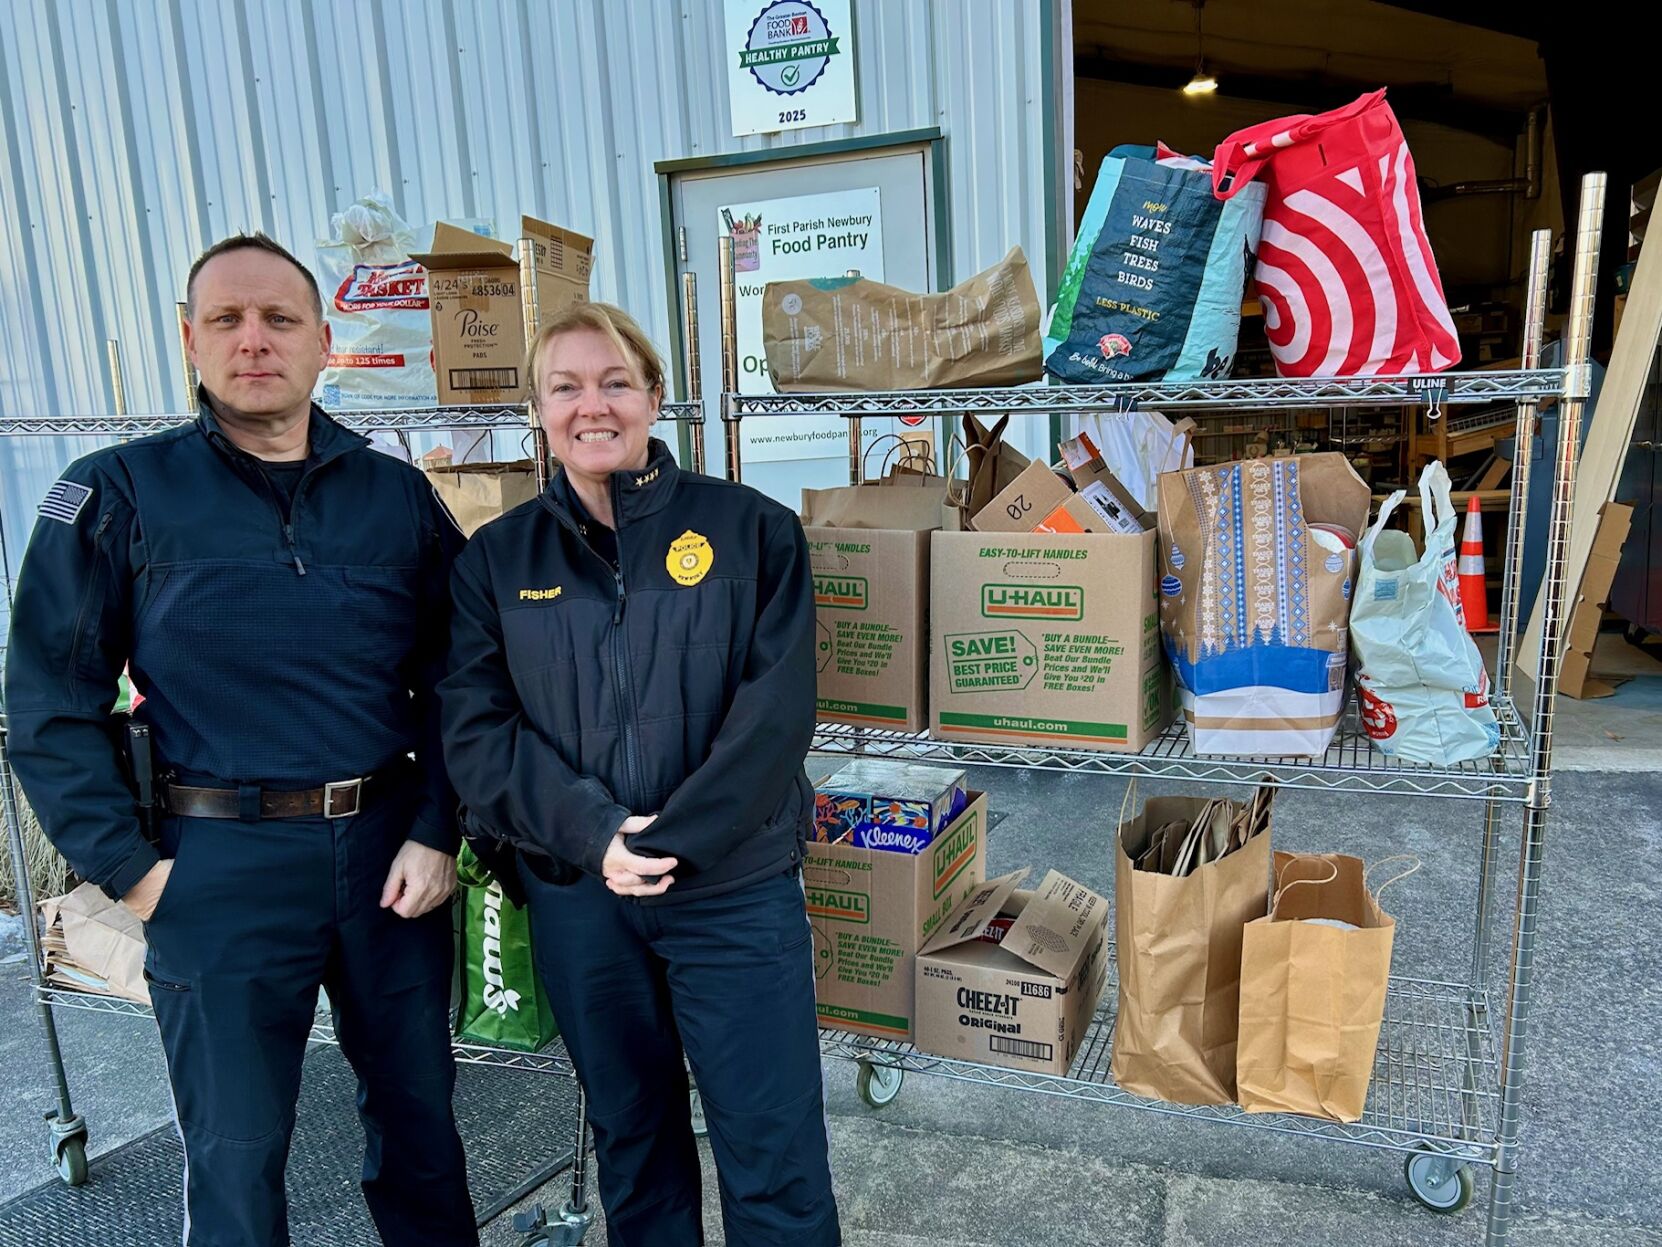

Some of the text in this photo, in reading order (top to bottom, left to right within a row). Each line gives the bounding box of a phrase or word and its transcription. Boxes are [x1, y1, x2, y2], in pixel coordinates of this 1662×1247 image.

[767, 19, 791, 31] FOOD
[768, 28, 792, 40] BANK
[745, 42, 829, 64] HEALTHY PANTRY
[779, 109, 806, 123] 2025
[767, 214, 873, 236] First Parish Newbury
[1131, 214, 1172, 234] WAVES
[773, 235, 812, 255] Food
[817, 232, 869, 250] Pantry
[1129, 234, 1160, 252] FISH
[1123, 252, 1160, 272] TREES
[1117, 270, 1154, 290] BIRDS
[739, 285, 765, 297] Wor
[1096, 296, 1160, 322] LESS PLASTIC
[454, 308, 499, 338] Poise
[356, 357, 370, 365] 125
[372, 356, 396, 365] times
[743, 355, 770, 378] Op
[1098, 364, 1118, 380] Bring
[1412, 378, 1447, 388] ULINE
[750, 427, 878, 445] www.newburyfoodpan.org
[1006, 494, 1032, 520] 20
[979, 548, 1088, 560] EASY-TO-LIFT HANDLES
[520, 586, 562, 600] FISHER
[814, 580, 863, 597] HAUL
[988, 589, 1076, 607] U-HAUL
[836, 630, 903, 642] SAVE EVEN MORE!
[1064, 634, 1070, 642] A
[836, 649, 858, 657] Prices
[859, 650, 872, 658] and
[952, 636, 1016, 657] SAVE!
[1044, 644, 1124, 655] SAVE EVEN MORE!
[1082, 656, 1112, 664] Bundle
[837, 666, 880, 676] FREE Boxes!
[954, 662, 1018, 676] BEST PRICE
[1044, 664, 1069, 672] Prices
[1090, 665, 1111, 674] We'll
[1044, 673, 1062, 681] Give
[1064, 674, 1078, 682] You
[1044, 682, 1095, 692] FREE Boxes!
[816, 700, 858, 712] ul.com
[994, 717, 1068, 732] uhaul.com
[860, 827, 927, 854] Kleenex
[936, 822, 975, 878] U-HAUL
[804, 856, 873, 871] TO-LIFT HANDLES
[807, 892, 864, 912] -HAUL
[1068, 888, 1088, 912] FRAGILE
[922, 907, 941, 938] SMALL
[838, 941, 904, 957] SAVE EVEN MORE!
[838, 950, 854, 958] Beat
[870, 954, 894, 964] Bundle
[838, 958, 860, 967] Prices
[861, 962, 874, 970] and
[838, 966, 853, 974] Give
[855, 968, 867, 977] You
[882, 972, 890, 980] in
[838, 974, 882, 988] FREE Boxes!
[1022, 982, 1050, 998] 11686
[957, 987, 1020, 1016] CHEEZ-IT
[817, 1005, 859, 1020] ul.com
